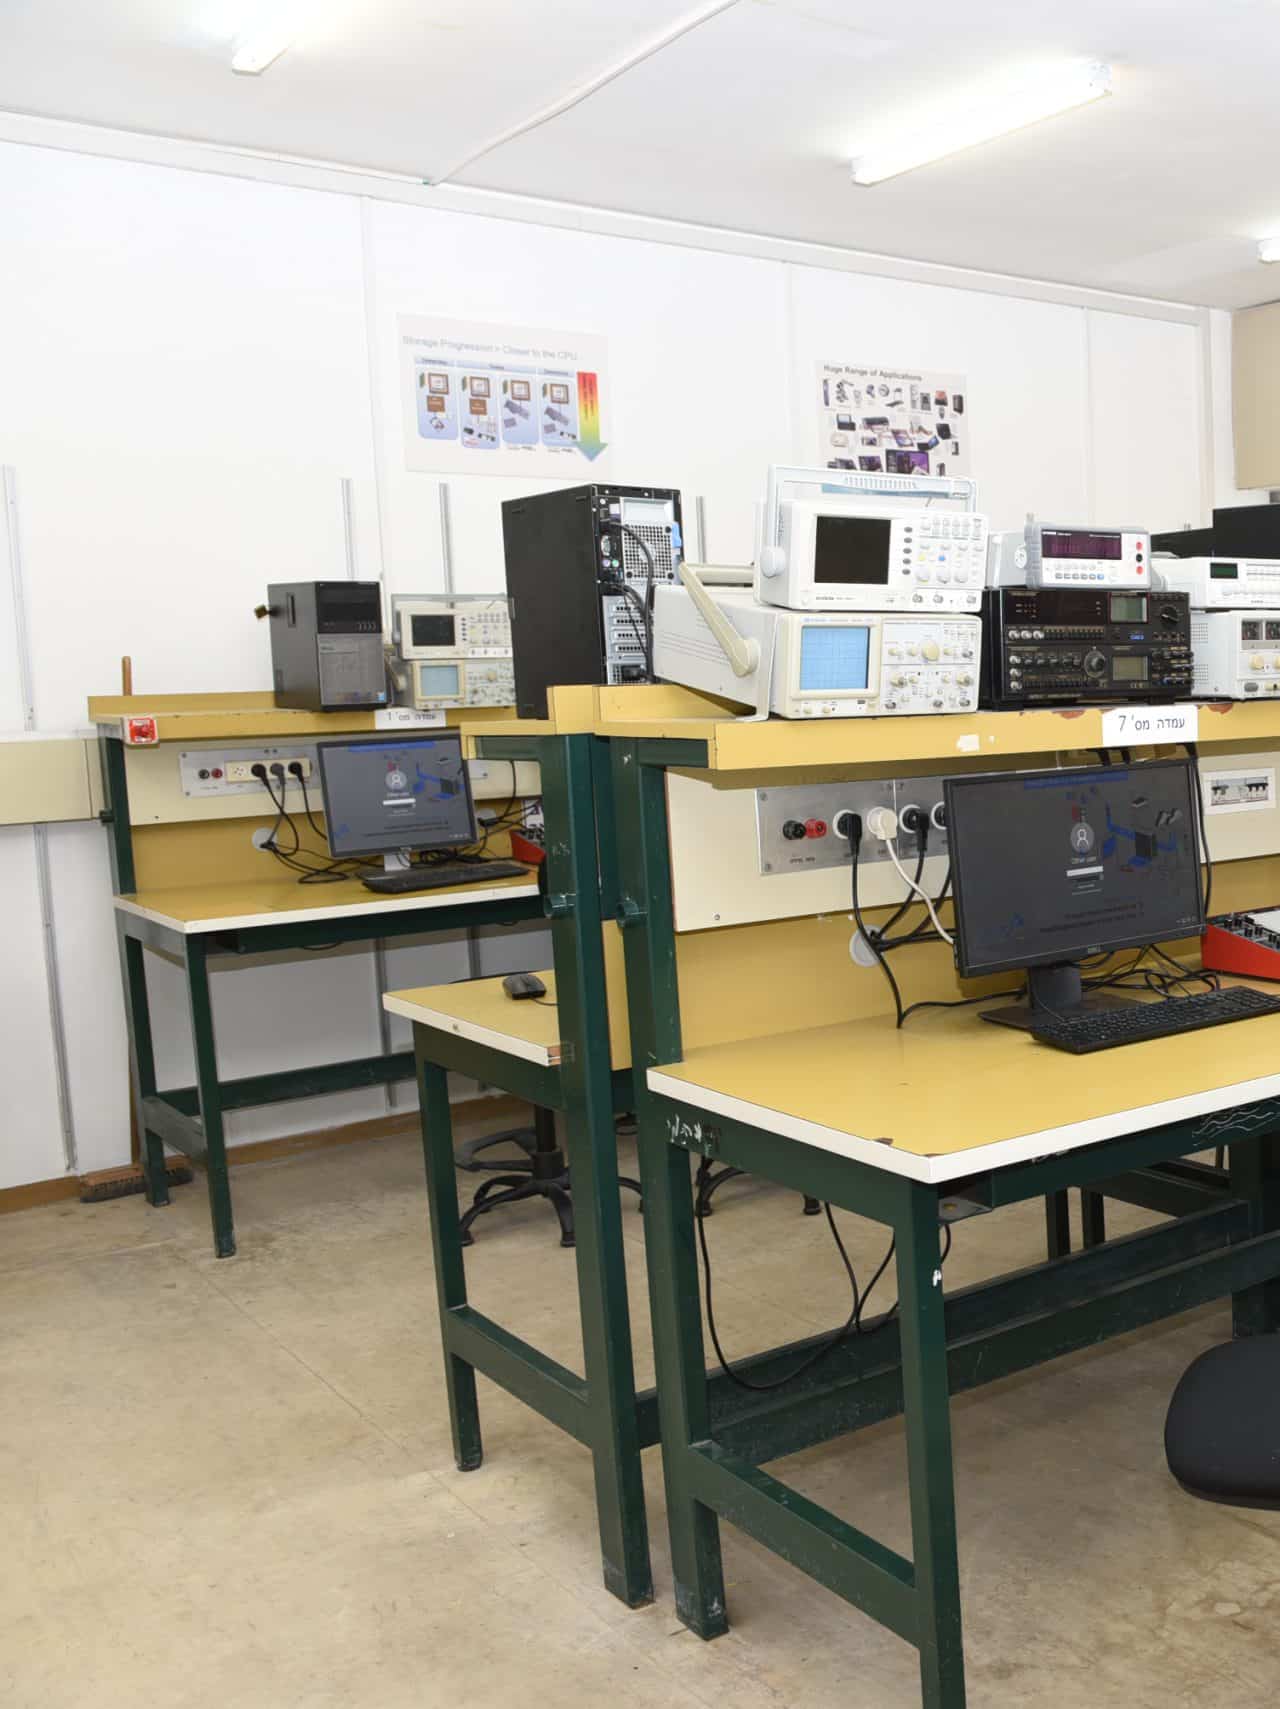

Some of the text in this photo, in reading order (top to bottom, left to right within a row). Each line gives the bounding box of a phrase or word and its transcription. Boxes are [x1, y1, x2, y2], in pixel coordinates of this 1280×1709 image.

[845, 366, 868, 377] Range
[870, 368, 878, 376] of
[1118, 714, 1127, 733] 7
[1157, 717, 1185, 729] עמדה
